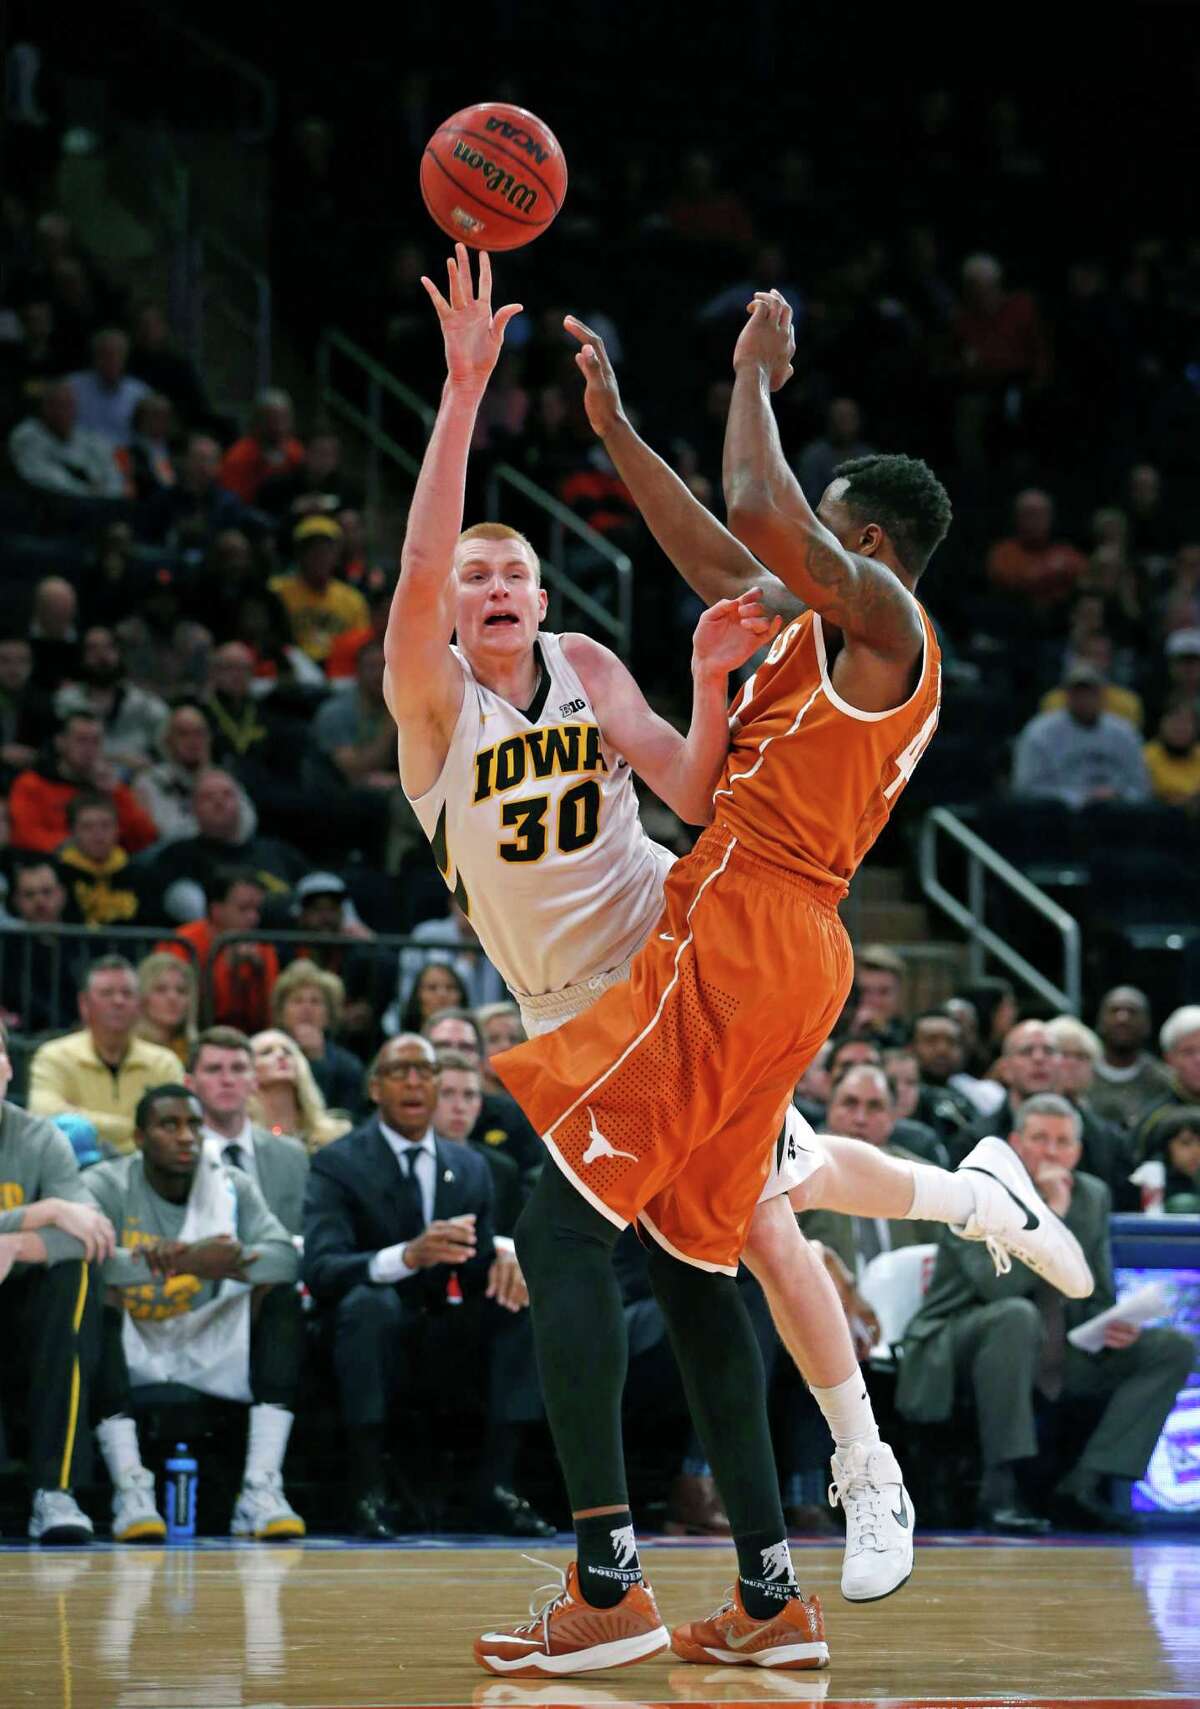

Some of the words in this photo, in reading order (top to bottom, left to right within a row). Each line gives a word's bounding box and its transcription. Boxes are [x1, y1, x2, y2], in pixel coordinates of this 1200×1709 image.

[453, 140, 539, 214] Wilson
[485, 117, 549, 164] NCAA
[472, 724, 609, 806] IOWA
[497, 777, 603, 863] 30
